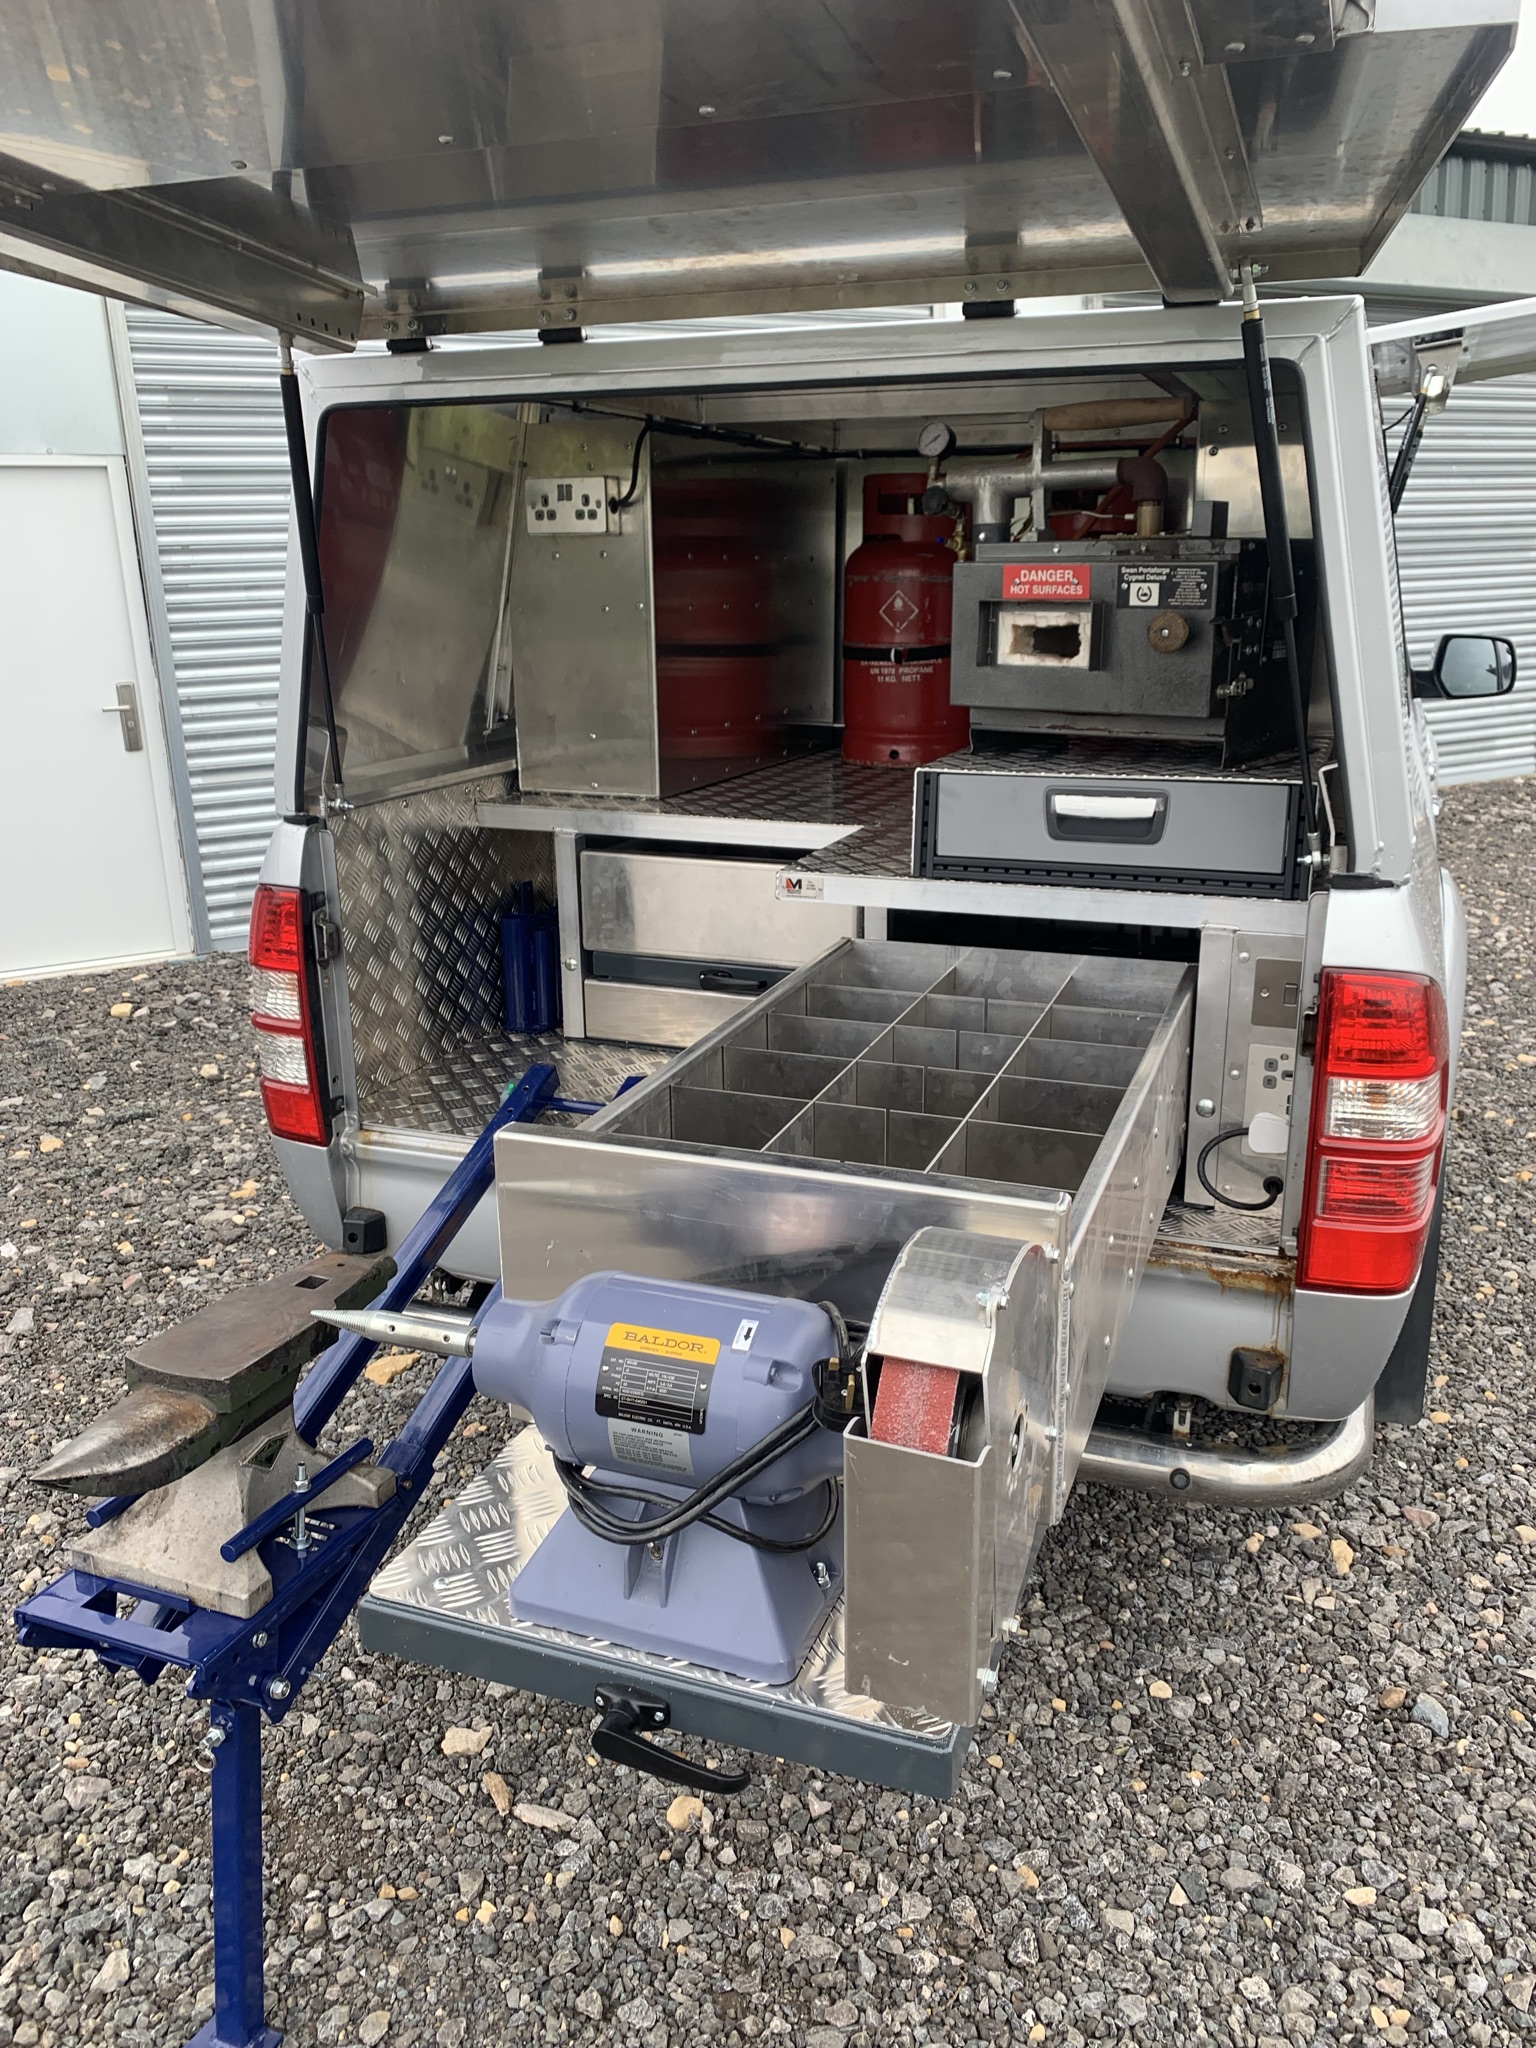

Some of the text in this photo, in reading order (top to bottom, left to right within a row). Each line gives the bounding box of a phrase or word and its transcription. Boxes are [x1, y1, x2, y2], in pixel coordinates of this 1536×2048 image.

[1138, 566, 1170, 575] Portaforge
[1020, 570, 1073, 582] DANGER
[1010, 585, 1083, 594] HOT SURFACES
[899, 666, 934, 674] PROPANE
[623, 1332, 704, 1354] BALDOR
[630, 1427, 664, 1438] WARNING
